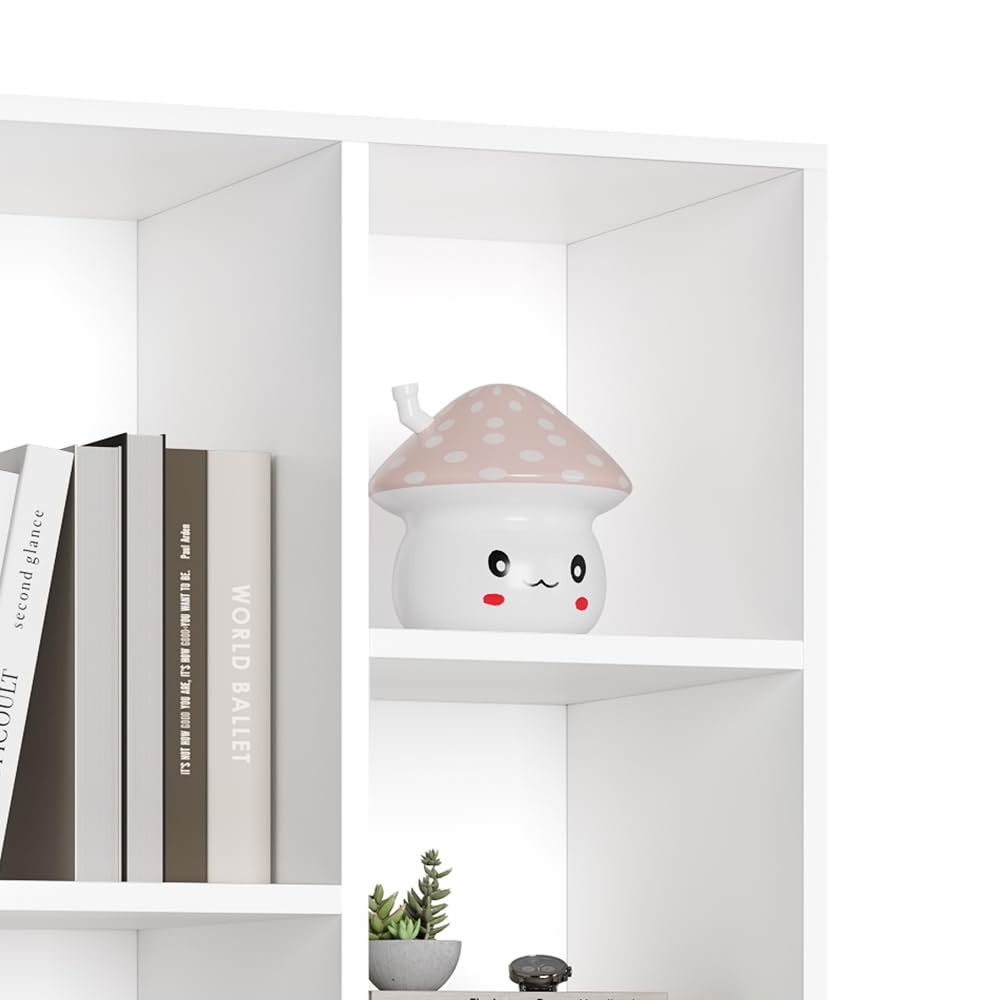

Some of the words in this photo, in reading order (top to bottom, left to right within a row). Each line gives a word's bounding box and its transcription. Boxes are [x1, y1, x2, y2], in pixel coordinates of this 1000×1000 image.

[23, 509, 44, 565] glance
[180, 524, 191, 542] Arden
[180, 544, 191, 559] Paul
[180, 583, 191, 591] TO
[14, 570, 33, 630] second
[180, 593, 191, 611] WANT
[231, 585, 250, 670] WORLD
[180, 648, 191, 662] HOW
[180, 696, 191, 710] YOU
[231, 682, 251, 764] BALLET
[180, 730, 191, 745] HOW
[180, 748, 191, 760] NOT
